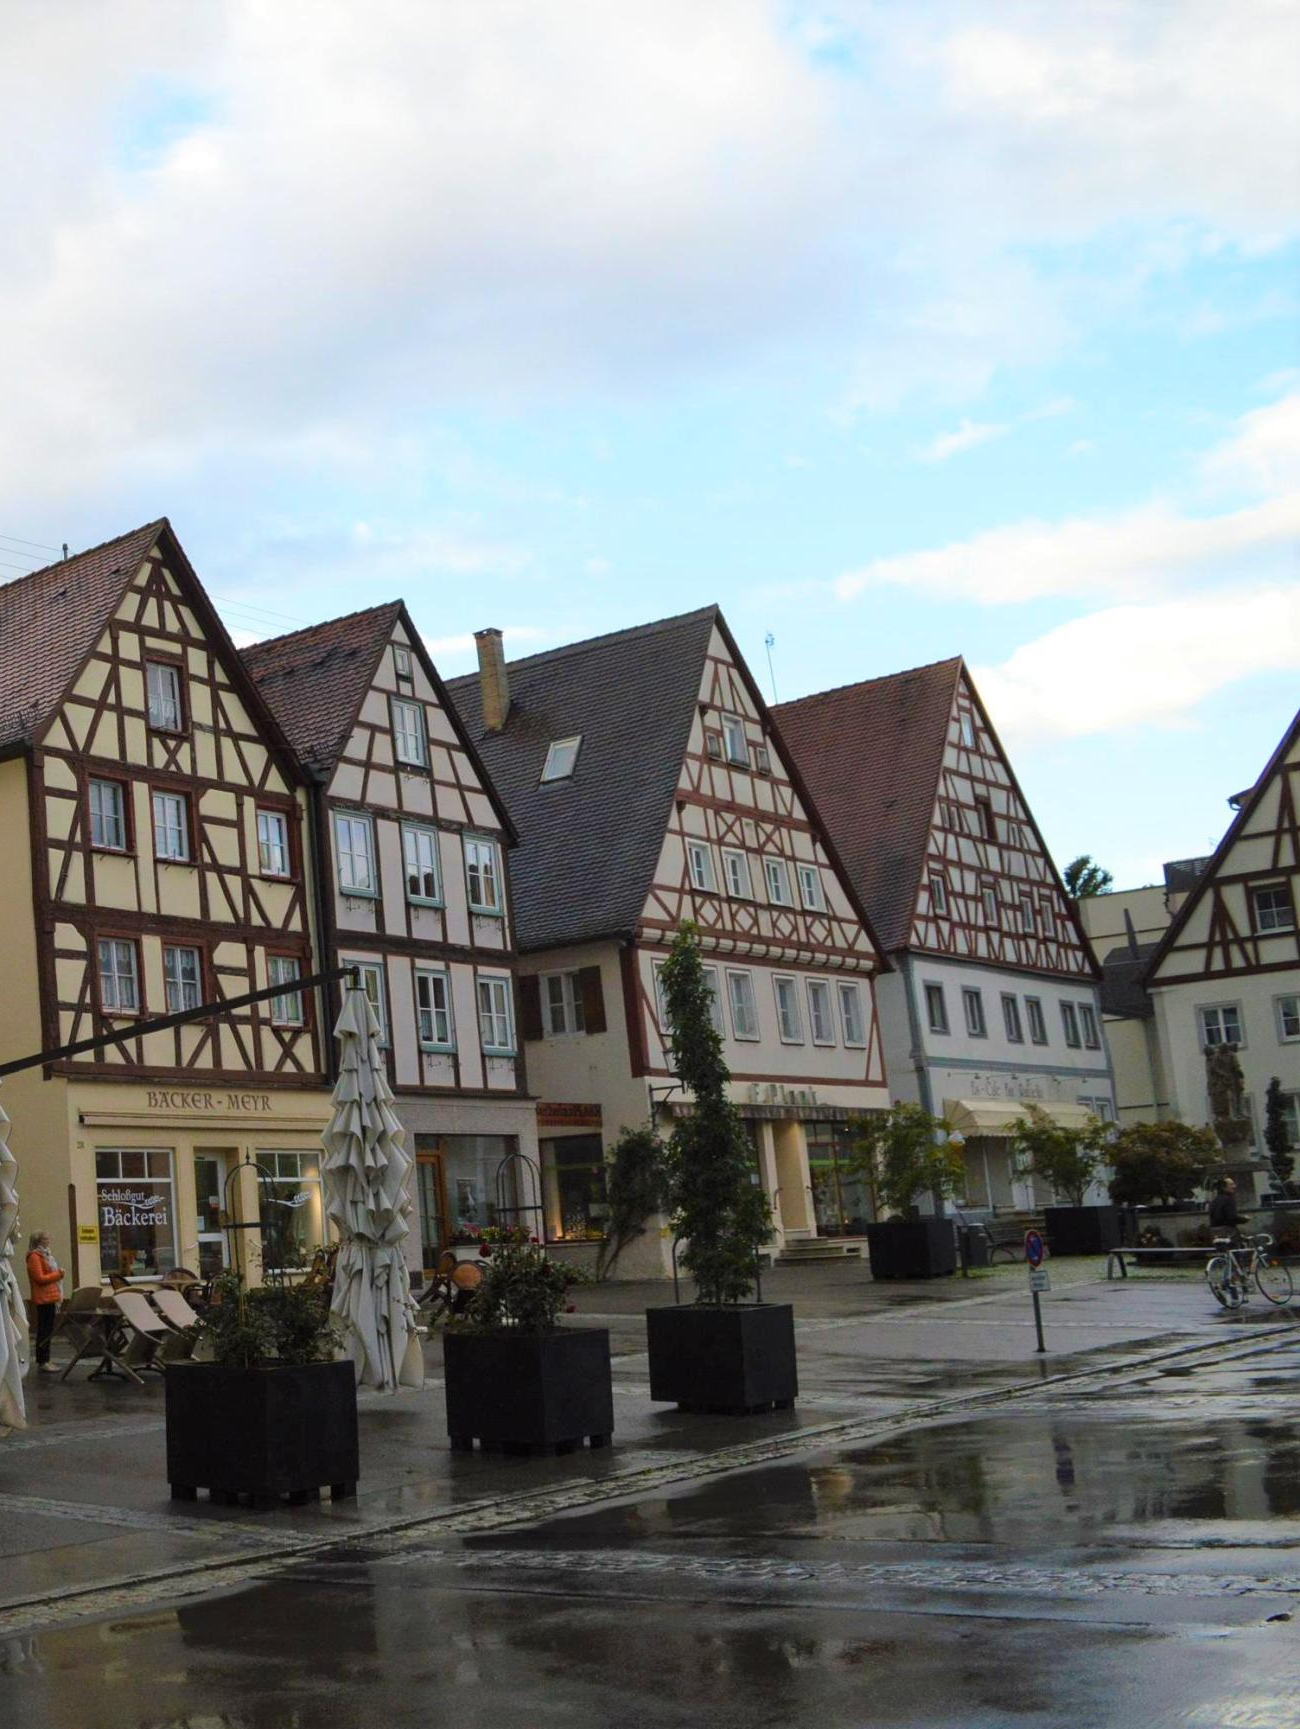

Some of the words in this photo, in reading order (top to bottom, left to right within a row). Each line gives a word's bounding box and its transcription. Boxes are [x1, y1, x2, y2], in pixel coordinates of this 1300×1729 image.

[147, 1091, 214, 1109] BÄCKER
[226, 1094, 272, 1111] MEYR
[101, 1189, 145, 1204] Schloßgut
[102, 1206, 168, 1226] Bäckerei
